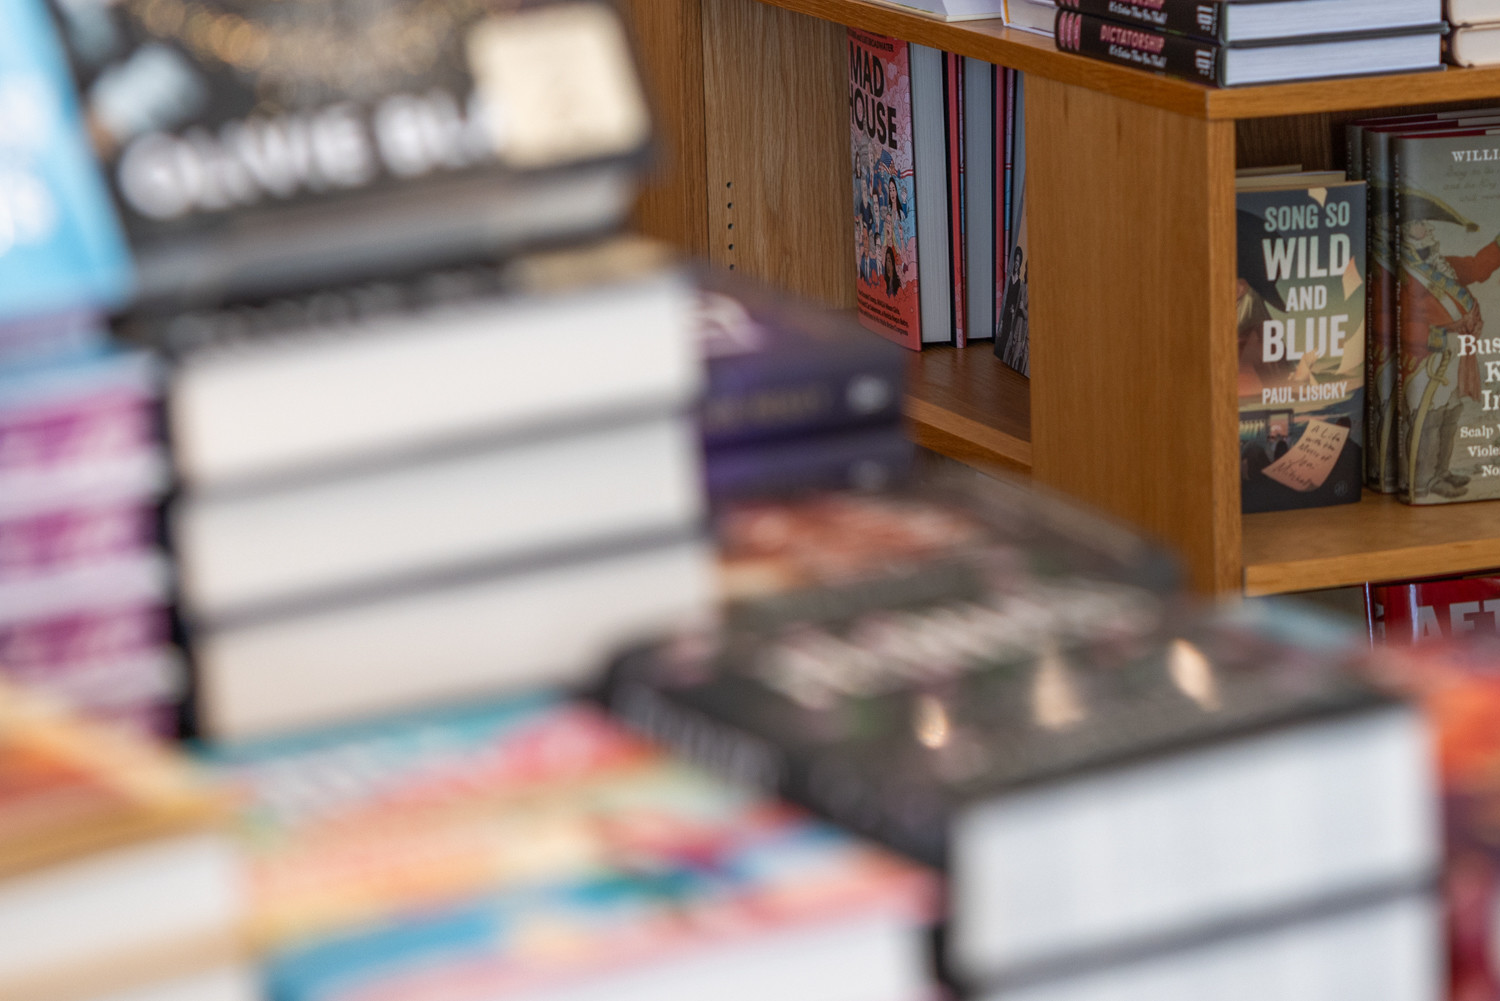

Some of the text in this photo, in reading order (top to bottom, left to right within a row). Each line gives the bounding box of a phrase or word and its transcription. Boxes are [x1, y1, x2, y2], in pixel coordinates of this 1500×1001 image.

[1265, 201, 1350, 232] SONG SO
[1262, 233, 1351, 282] WILD
[1286, 285, 1327, 312] AND
[1262, 314, 1348, 364] BLUE
[1262, 381, 1347, 405] PAUL LISICKY
[1460, 426, 1493, 439] Scalp
